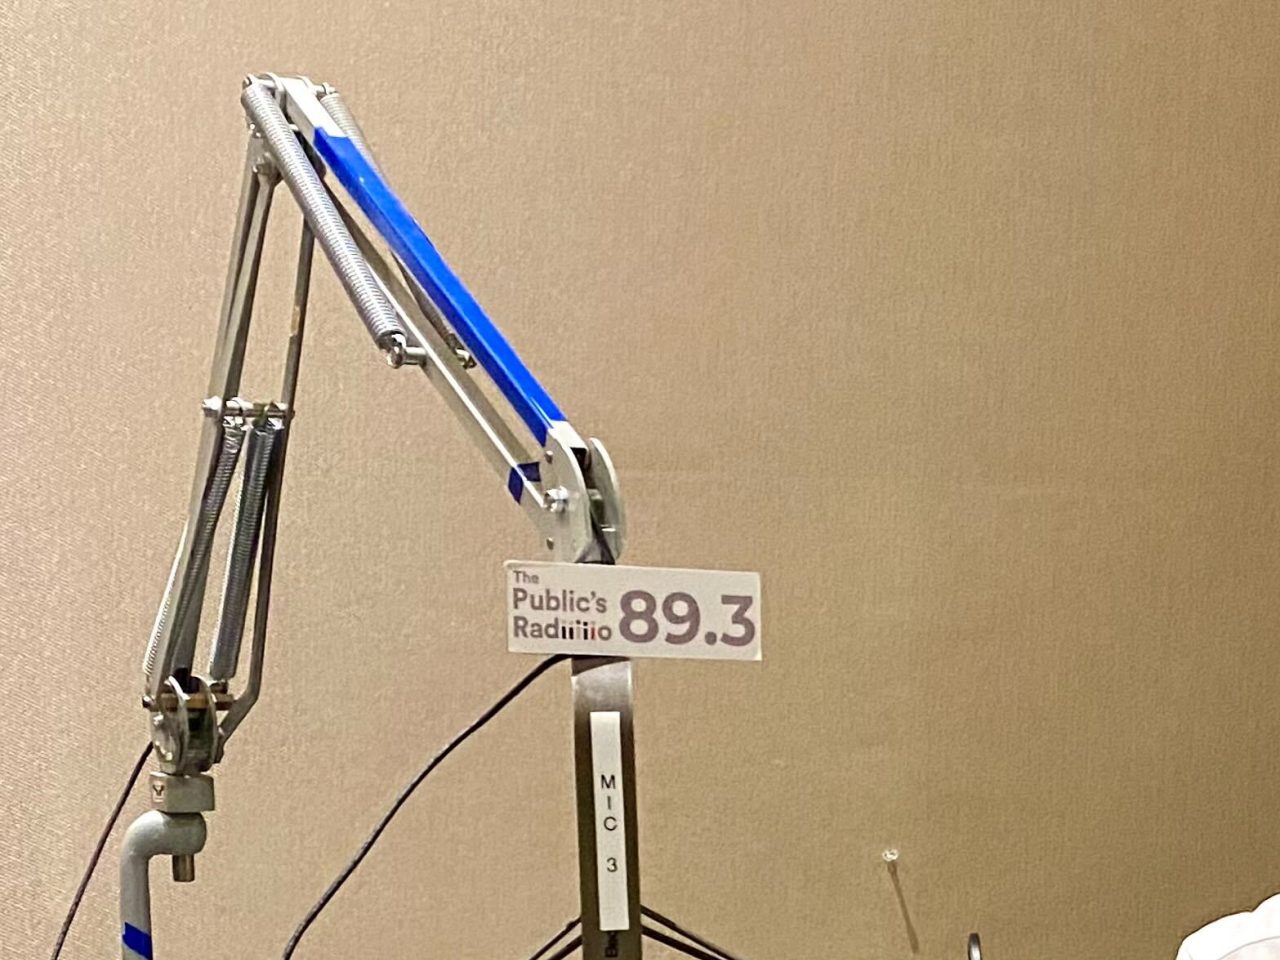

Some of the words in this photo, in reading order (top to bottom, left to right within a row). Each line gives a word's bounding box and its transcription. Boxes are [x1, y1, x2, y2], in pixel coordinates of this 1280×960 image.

[513, 570, 539, 584] The
[513, 587, 608, 613] Public's
[618, 589, 756, 647] 89.3
[600, 774, 618, 831] MIC
[606, 857, 618, 873] 3
